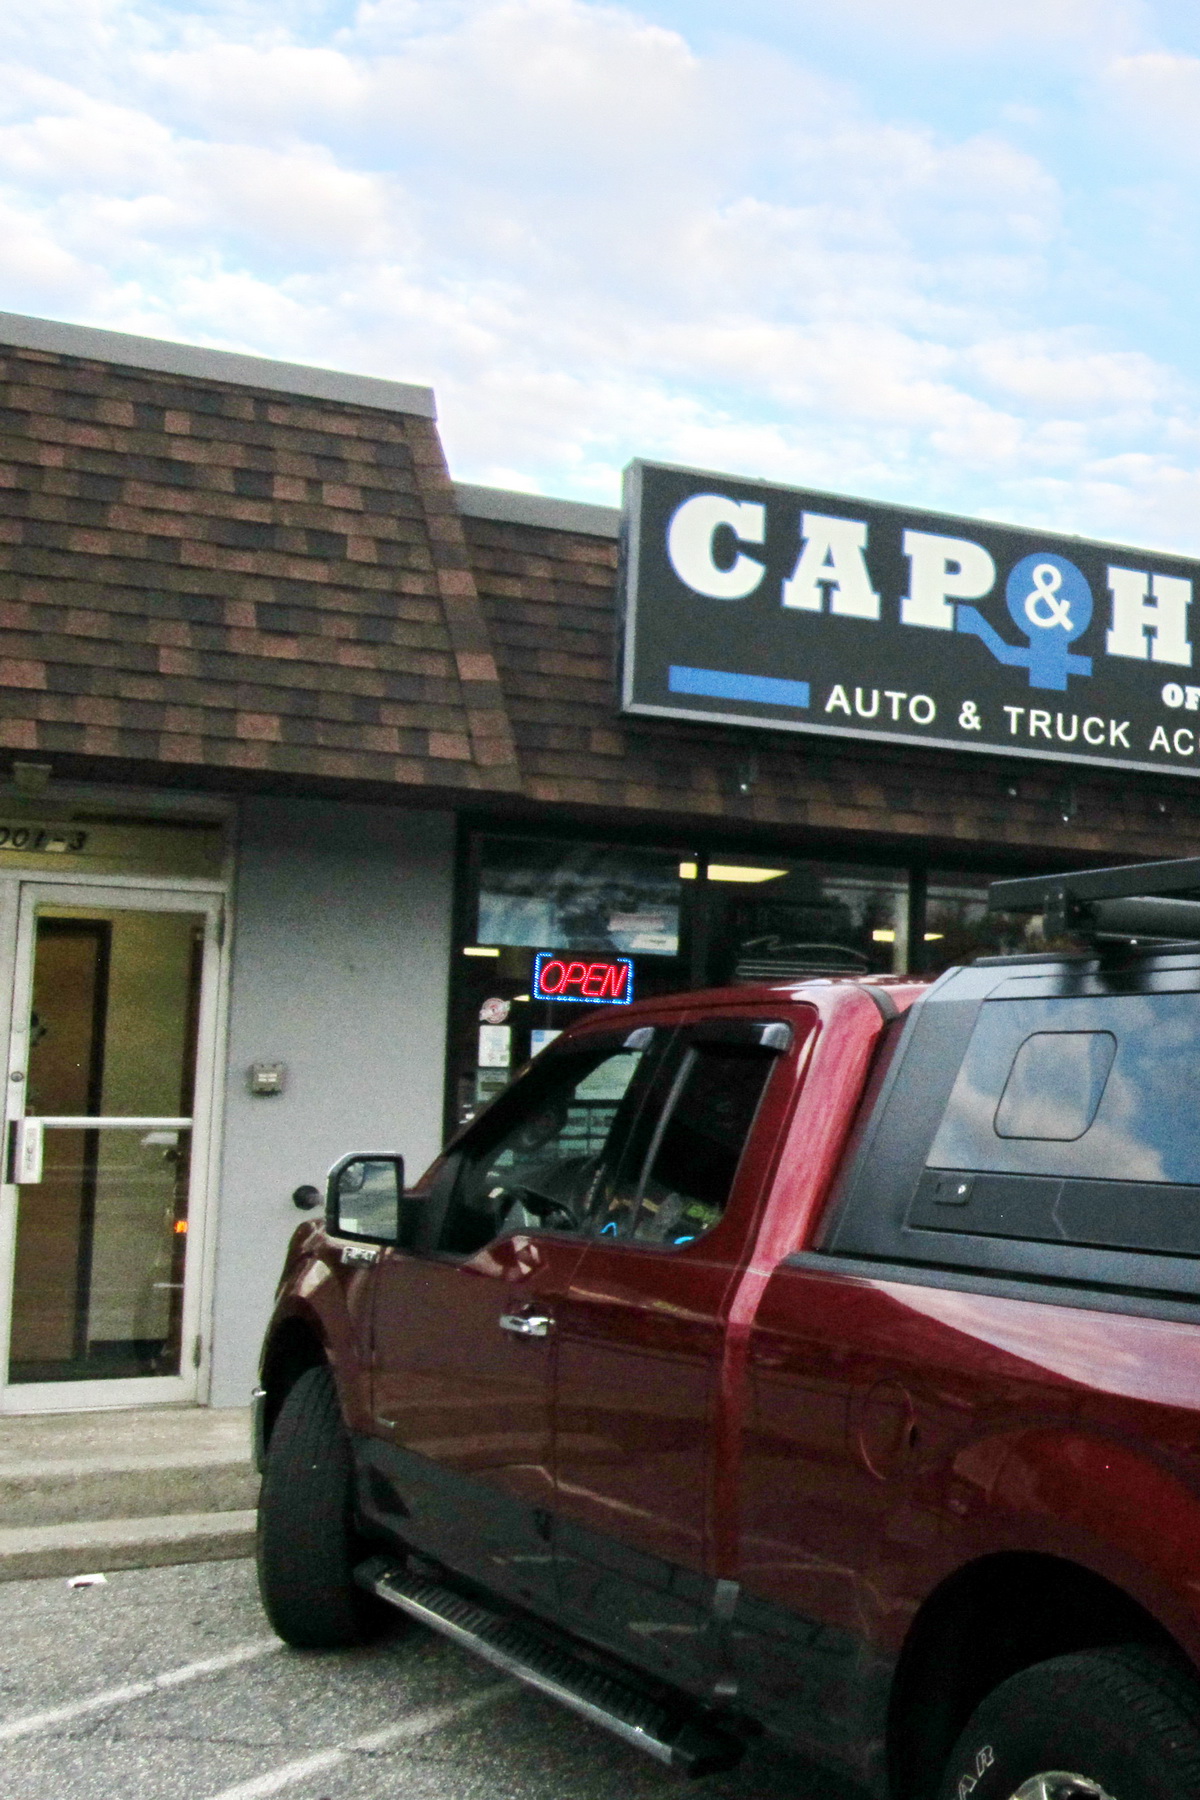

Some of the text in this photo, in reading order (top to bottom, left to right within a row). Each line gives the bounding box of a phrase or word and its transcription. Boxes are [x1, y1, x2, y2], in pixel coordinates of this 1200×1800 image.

[667, 492, 996, 631] CAP
[1024, 563, 1074, 631] &
[825, 684, 936, 725] AUTO
[958, 700, 981, 731] &
[1003, 705, 1131, 748] TRUCK
[540, 960, 628, 997] OPEN
